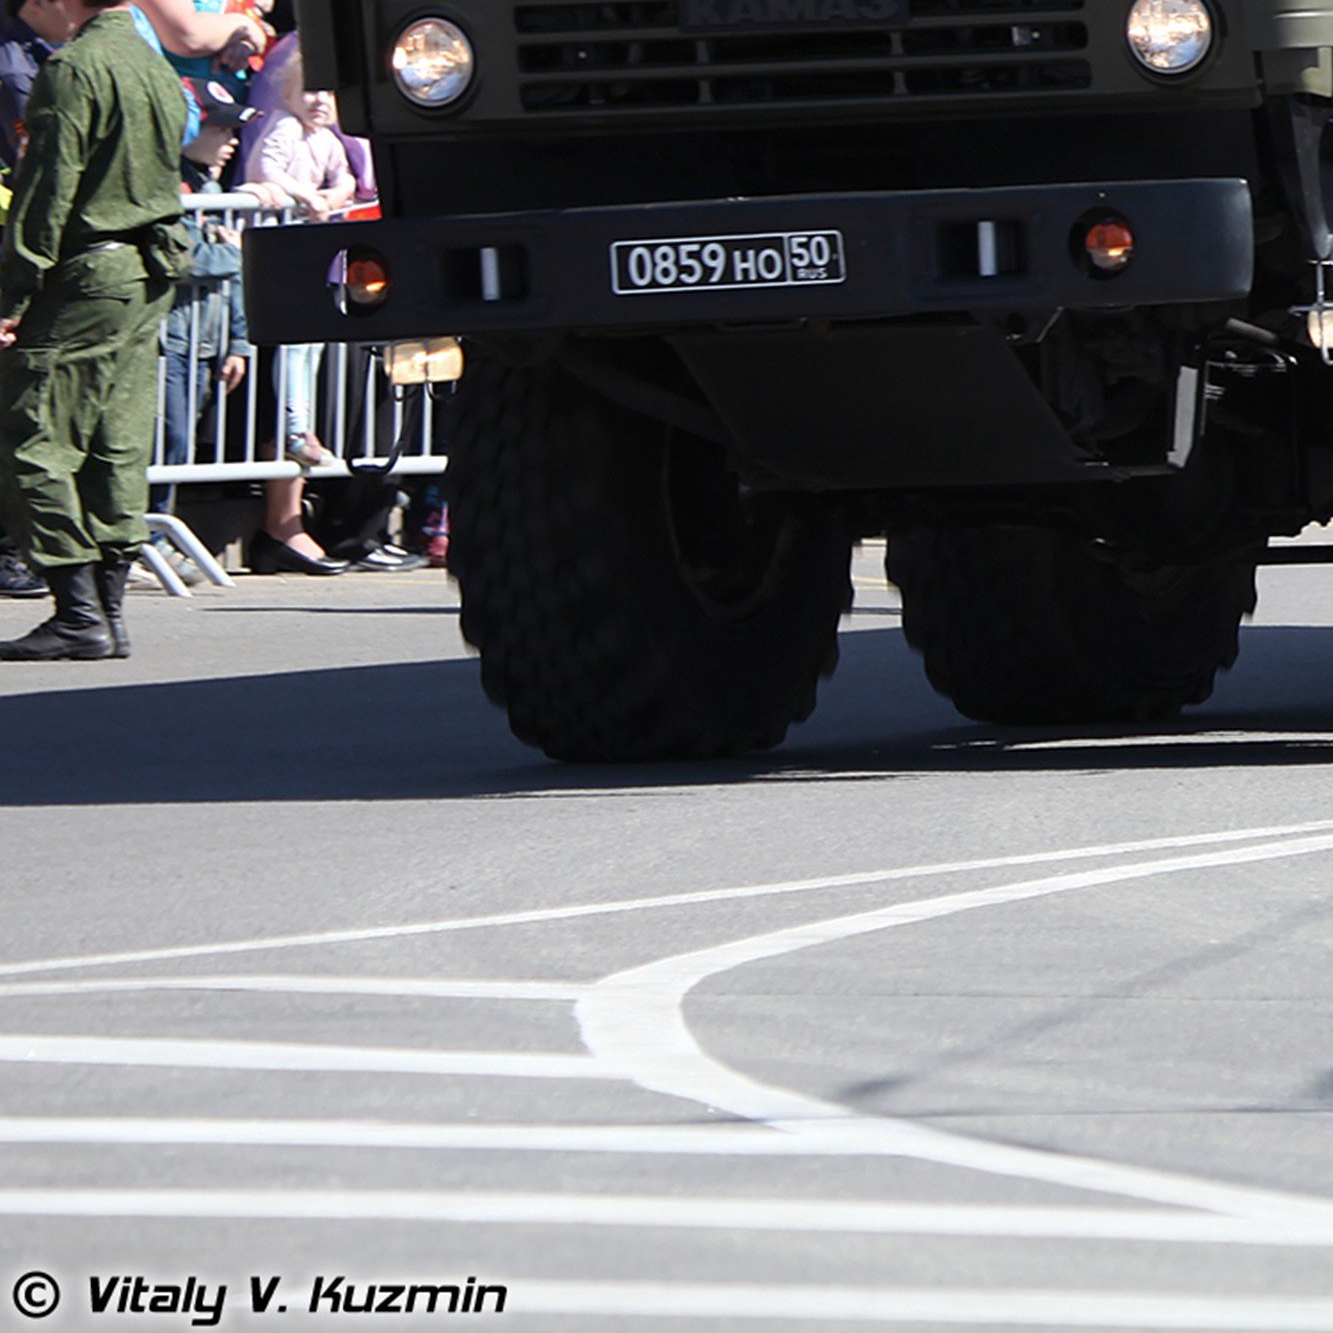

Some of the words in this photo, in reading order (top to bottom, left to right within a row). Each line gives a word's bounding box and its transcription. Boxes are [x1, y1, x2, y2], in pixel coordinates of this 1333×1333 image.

[628, 242, 726, 287] 0859
[791, 235, 831, 267] 50
[797, 267, 828, 279] RUS
